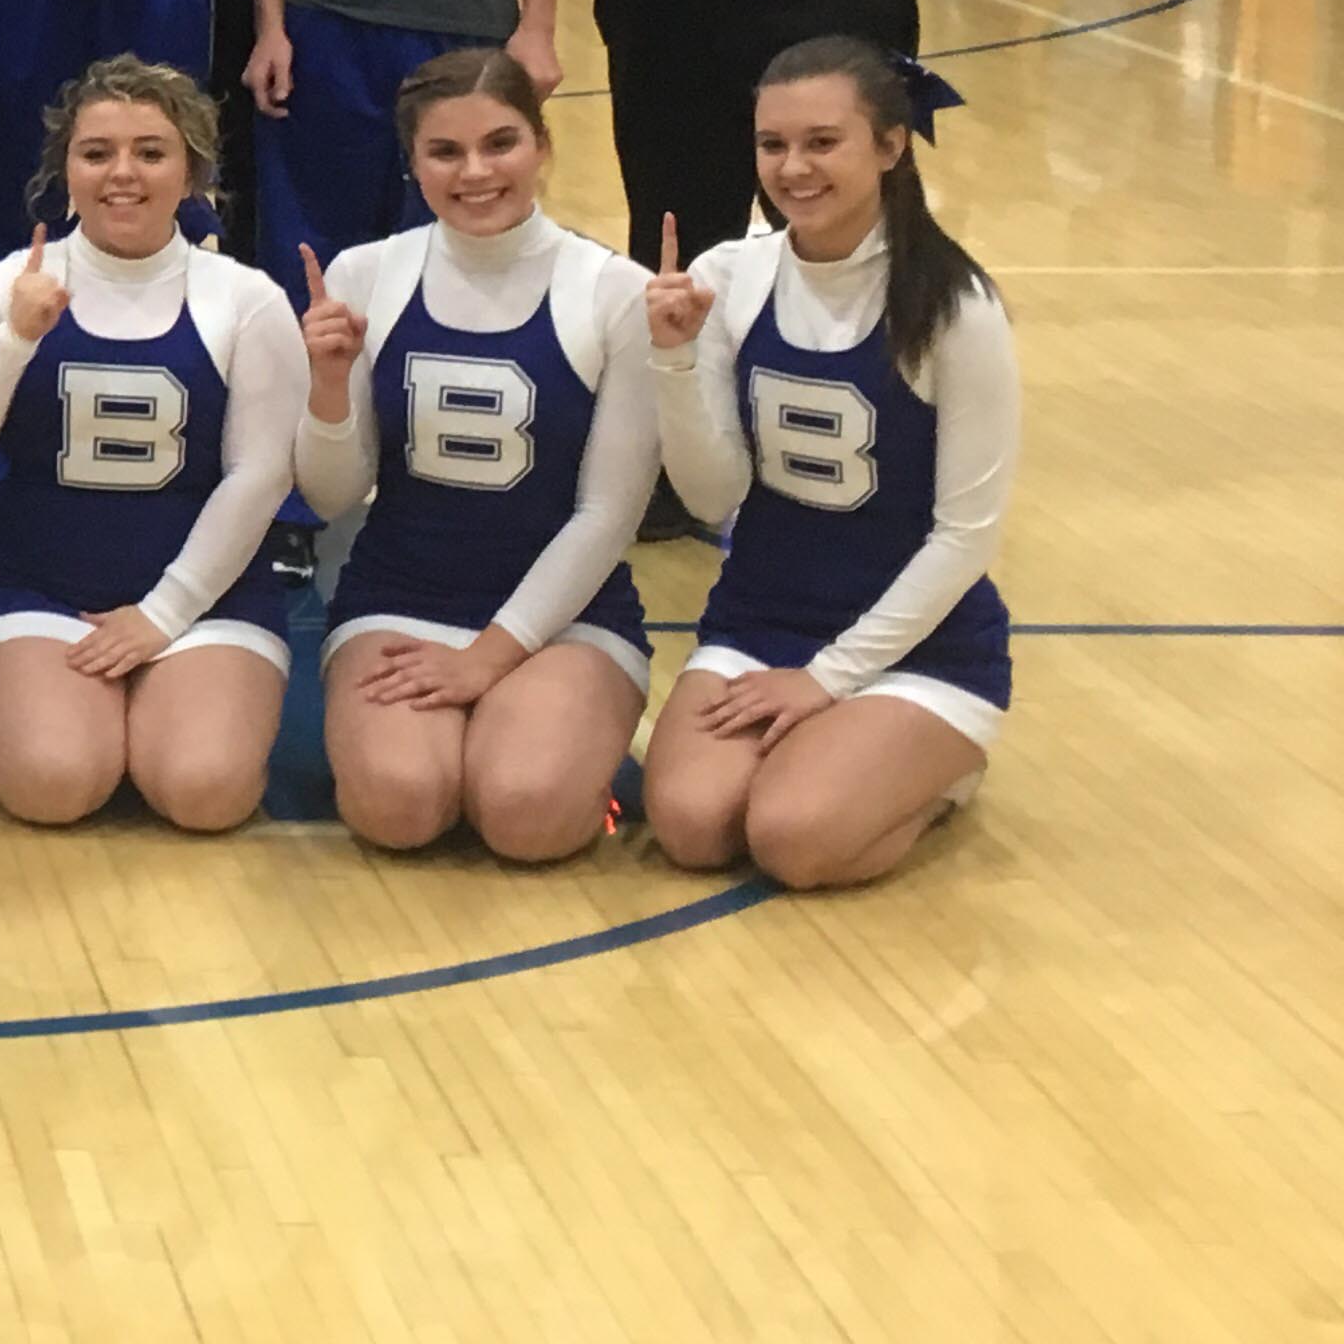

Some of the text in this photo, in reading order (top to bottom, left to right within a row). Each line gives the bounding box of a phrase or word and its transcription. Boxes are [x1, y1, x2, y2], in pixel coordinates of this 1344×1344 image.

[56, 361, 188, 490] B
[404, 352, 537, 491] B
[749, 366, 878, 512] B
